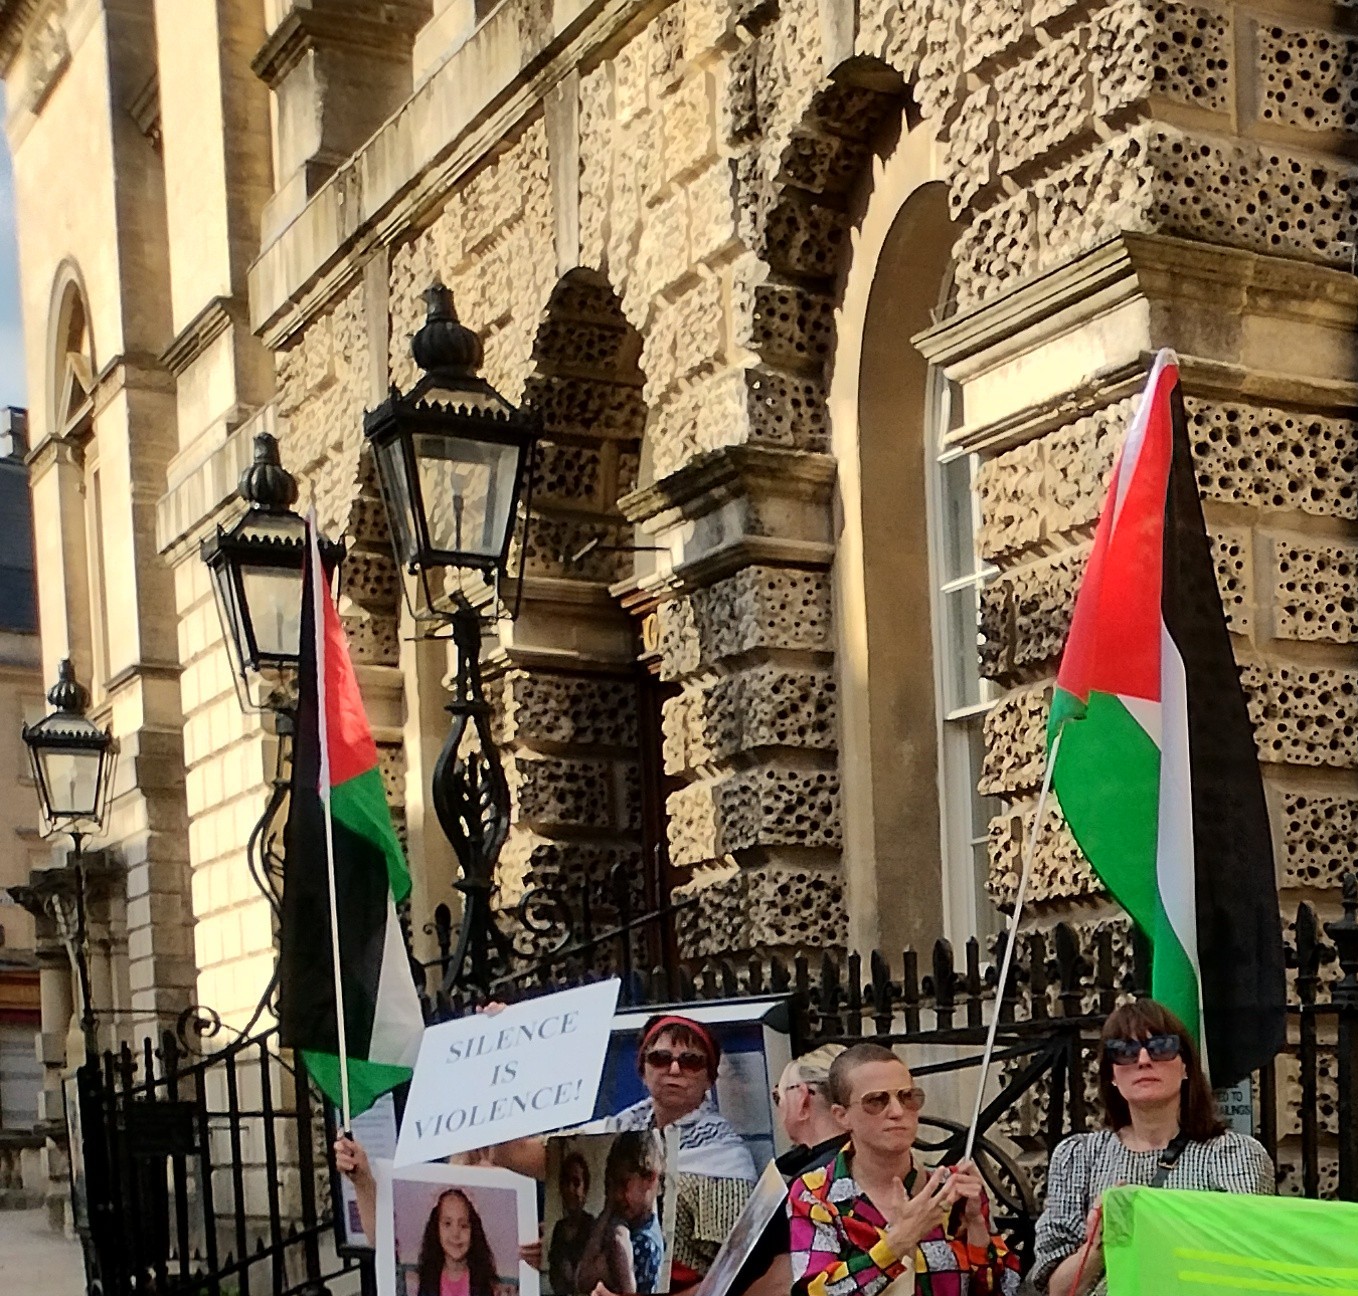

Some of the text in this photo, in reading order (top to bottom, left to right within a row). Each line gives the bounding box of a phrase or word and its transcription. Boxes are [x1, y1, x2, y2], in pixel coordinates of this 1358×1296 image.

[446, 1010, 580, 1064] SILENCE
[490, 1060, 519, 1086] IS
[414, 1079, 583, 1139] VIOLENCE!
